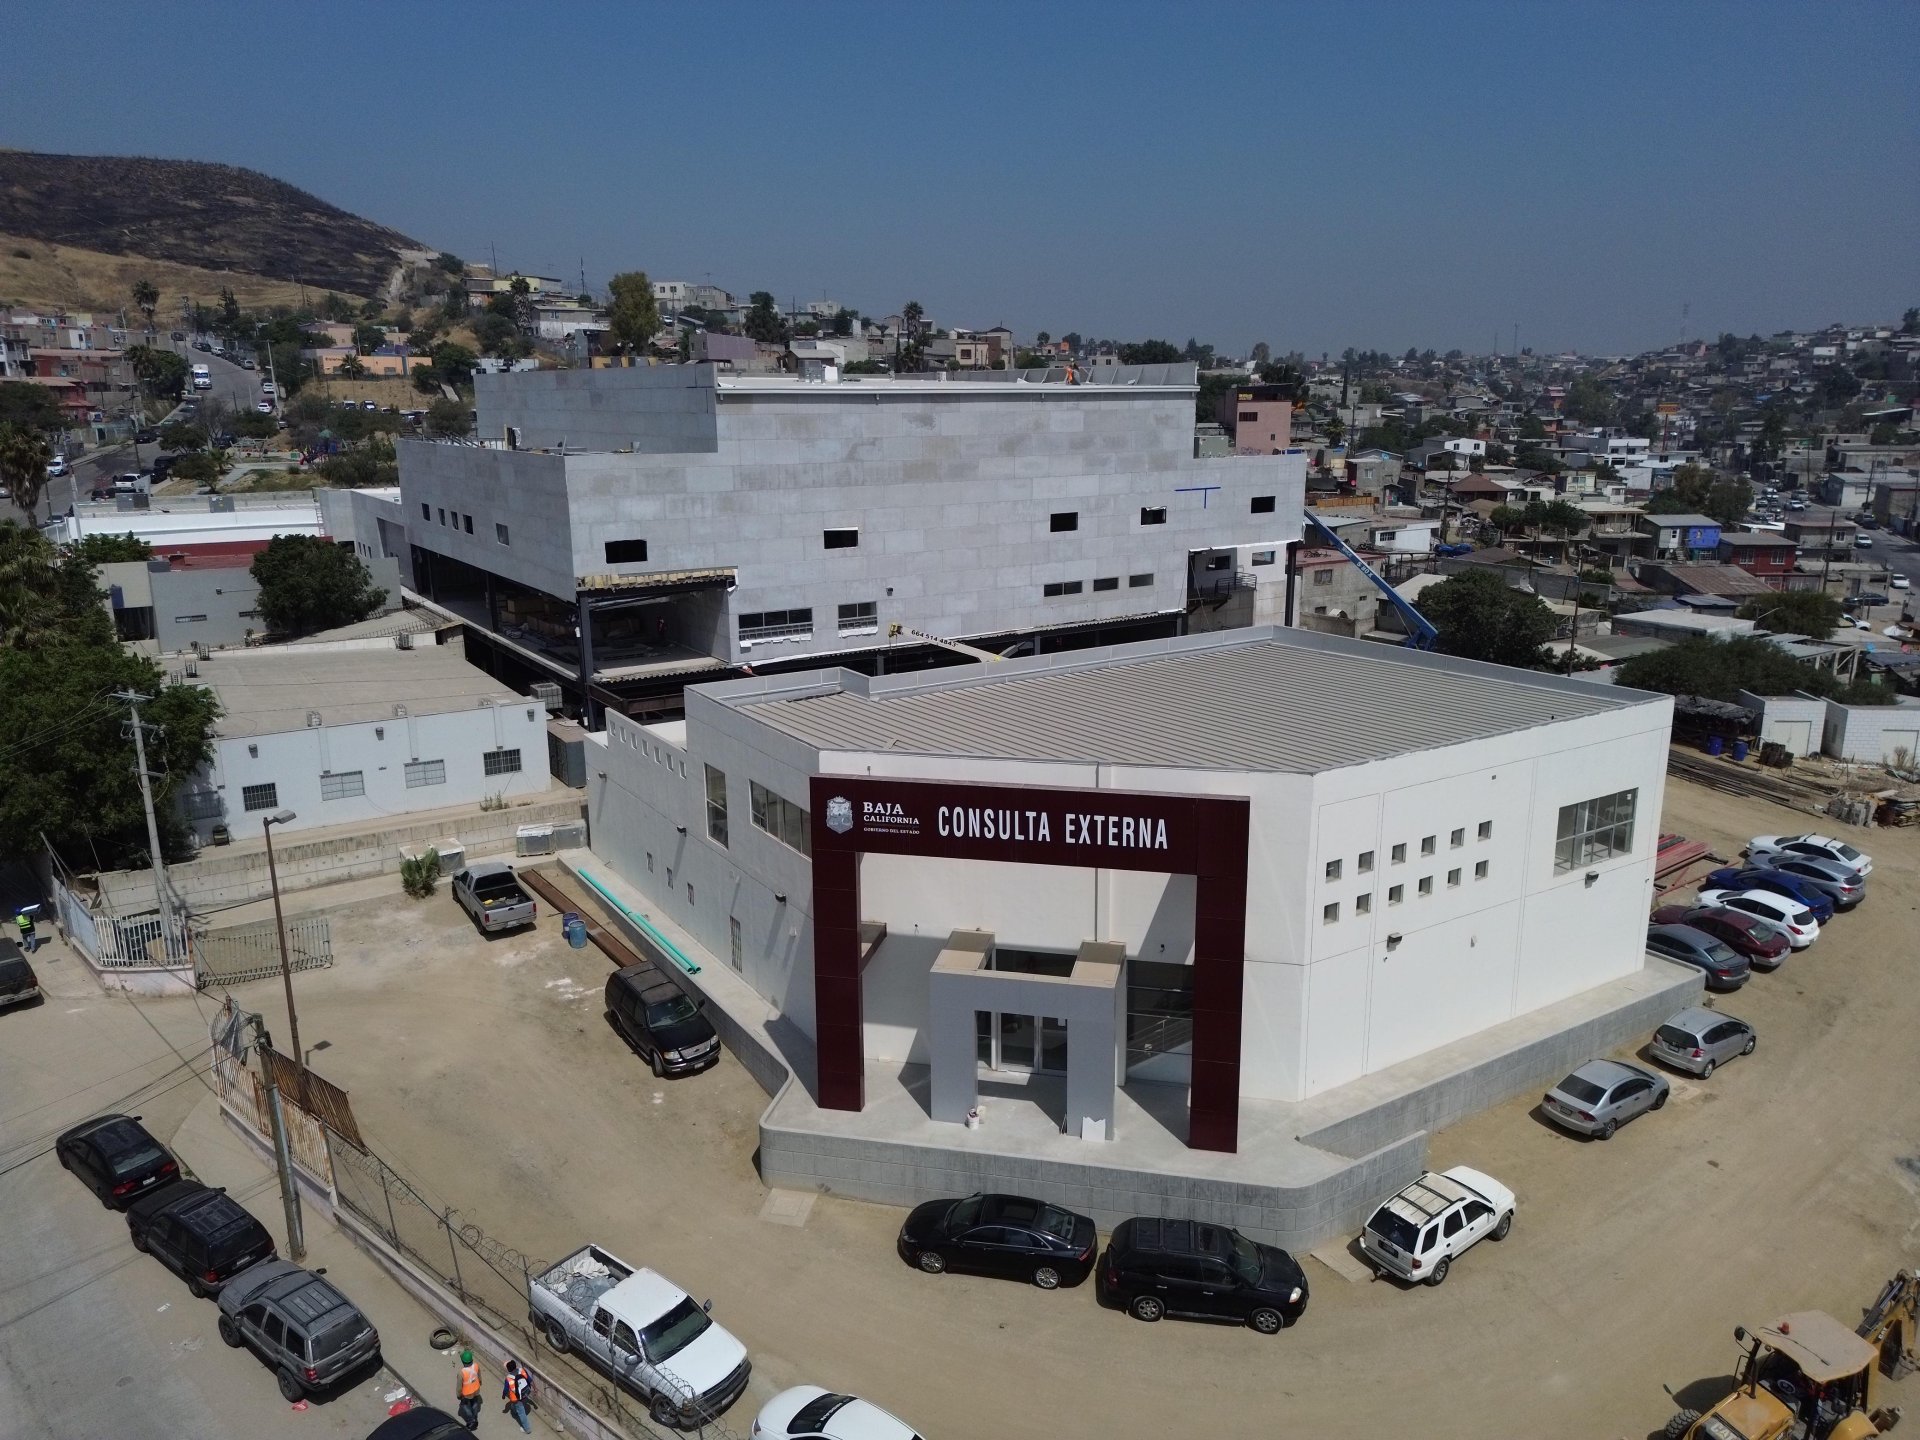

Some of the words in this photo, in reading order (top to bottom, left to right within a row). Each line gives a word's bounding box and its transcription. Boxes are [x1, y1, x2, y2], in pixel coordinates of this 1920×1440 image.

[911, 629, 925, 638] 664
[863, 801, 904, 815] BAJA
[863, 815, 920, 825] CALIFORNIA
[938, 805, 1051, 842] CONSULTA
[1065, 813, 1168, 850] EXTERNA
